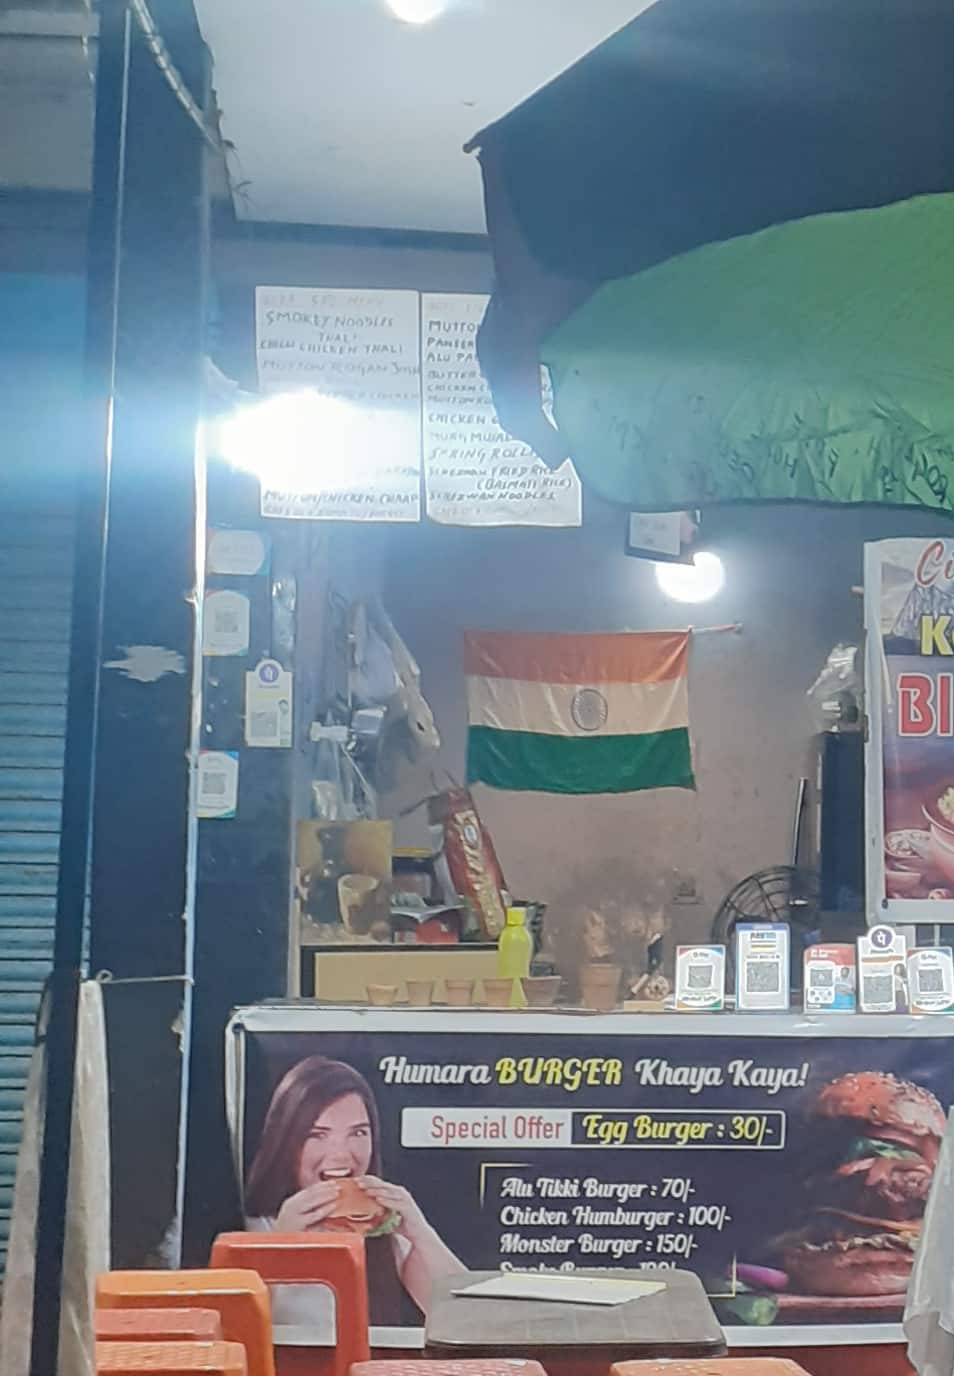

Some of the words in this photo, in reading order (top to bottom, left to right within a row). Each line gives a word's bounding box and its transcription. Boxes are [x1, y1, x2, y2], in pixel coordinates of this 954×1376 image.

[428, 320, 479, 333] MUTTO
[379, 1056, 493, 1085] Humara
[495, 1056, 623, 1091] BURGER
[635, 1058, 725, 1094] Khaya
[728, 1059, 810, 1094] Kaya!
[431, 1114, 507, 1145] Special
[514, 1115, 565, 1139] Offer
[583, 1114, 628, 1145] Egg
[633, 1114, 714, 1145] Burger
[729, 1115, 774, 1146] 30/-
[500, 1177, 534, 1198] Alu
[536, 1177, 581, 1198] Tikki
[582, 1177, 648, 1203] Burger
[660, 1178, 696, 1203] 70/-
[500, 1206, 569, 1226] Chicken
[572, 1206, 675, 1231] Humburger
[688, 1206, 731, 1231] 100/-
[500, 1233, 576, 1253] Monster
[578, 1233, 644, 1259] Burger
[656, 1234, 698, 1259] 150/-
